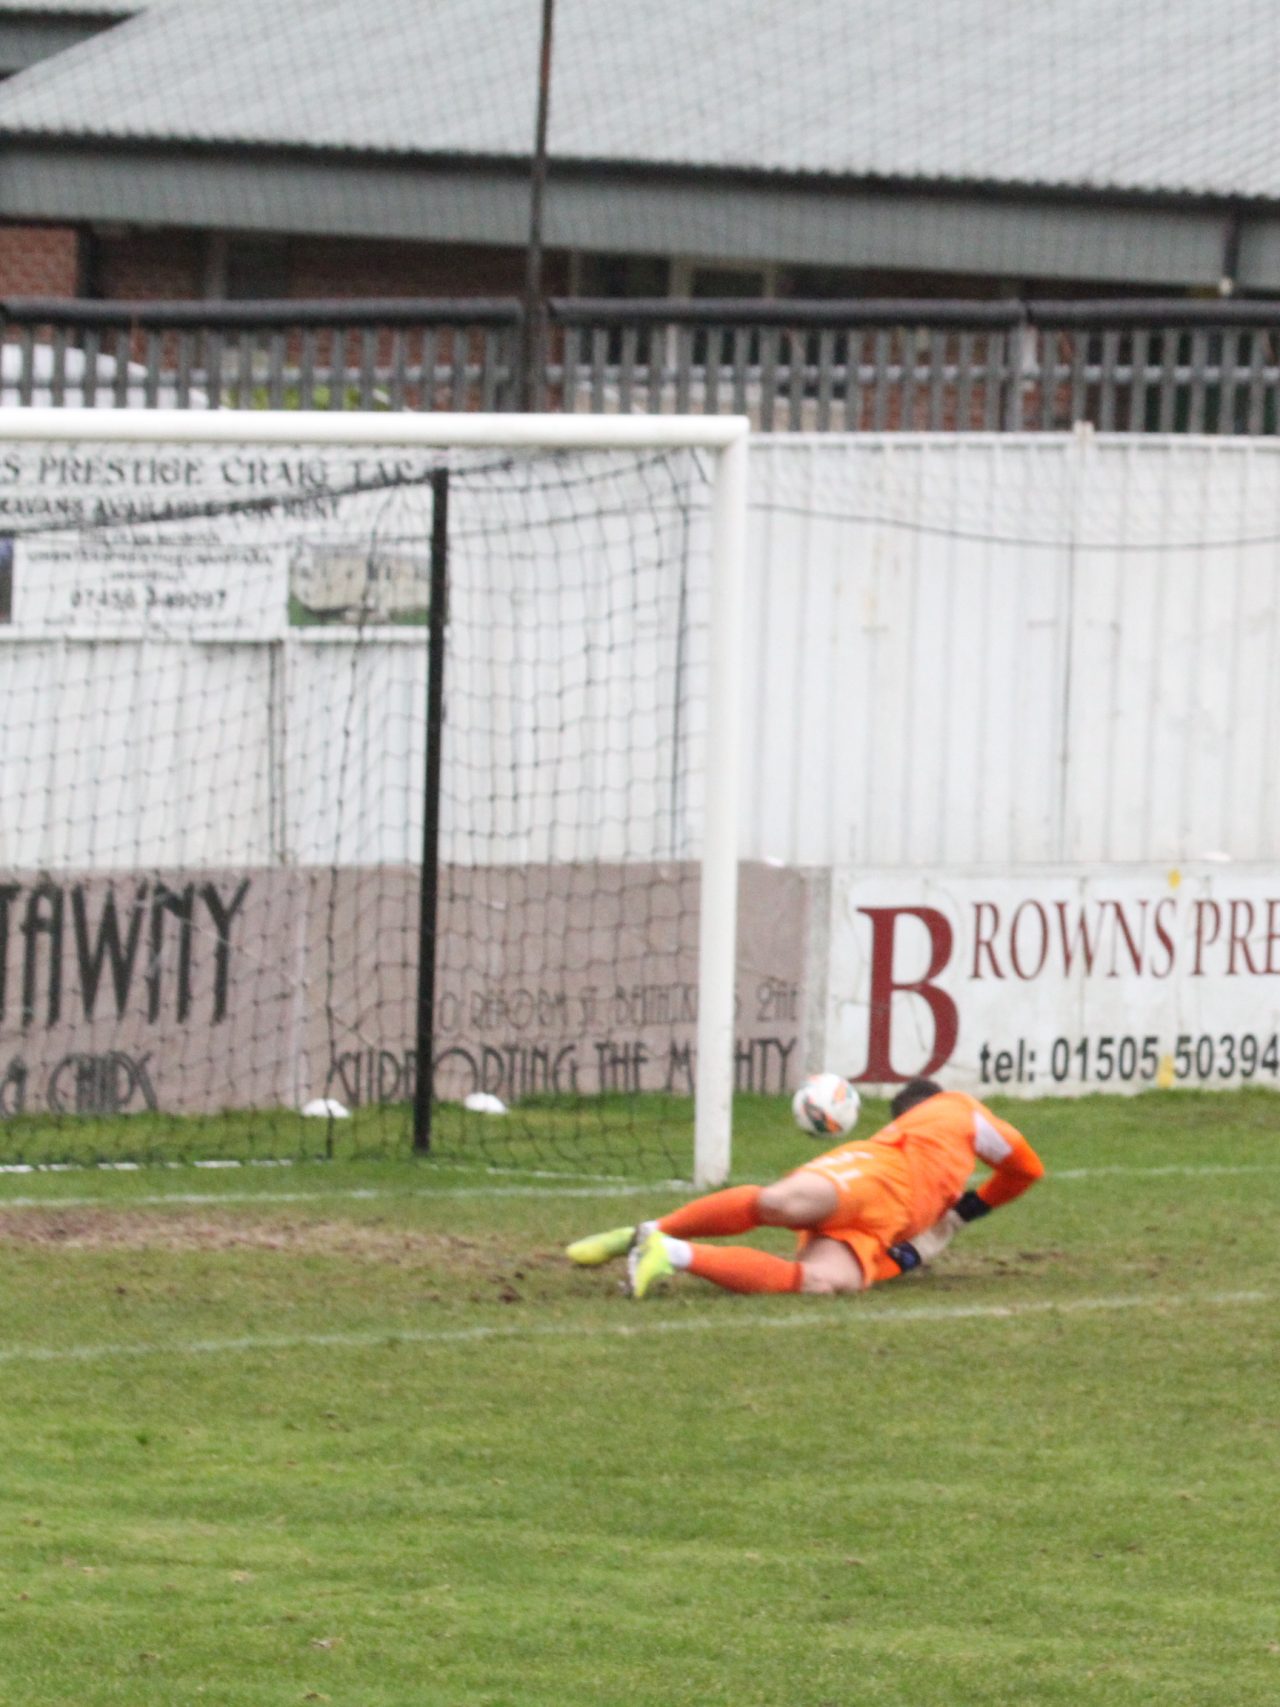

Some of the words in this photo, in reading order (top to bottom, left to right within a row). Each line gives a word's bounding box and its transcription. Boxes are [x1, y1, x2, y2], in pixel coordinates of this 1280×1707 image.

[38, 457, 203, 487] PRESTIGE
[851, 896, 1177, 1085] BROWNS
[595, 1041, 647, 1094] THE
[665, 1037, 797, 1095] MHTY
[978, 1041, 1036, 1084] tel:
[1051, 1034, 1160, 1083] 01505
